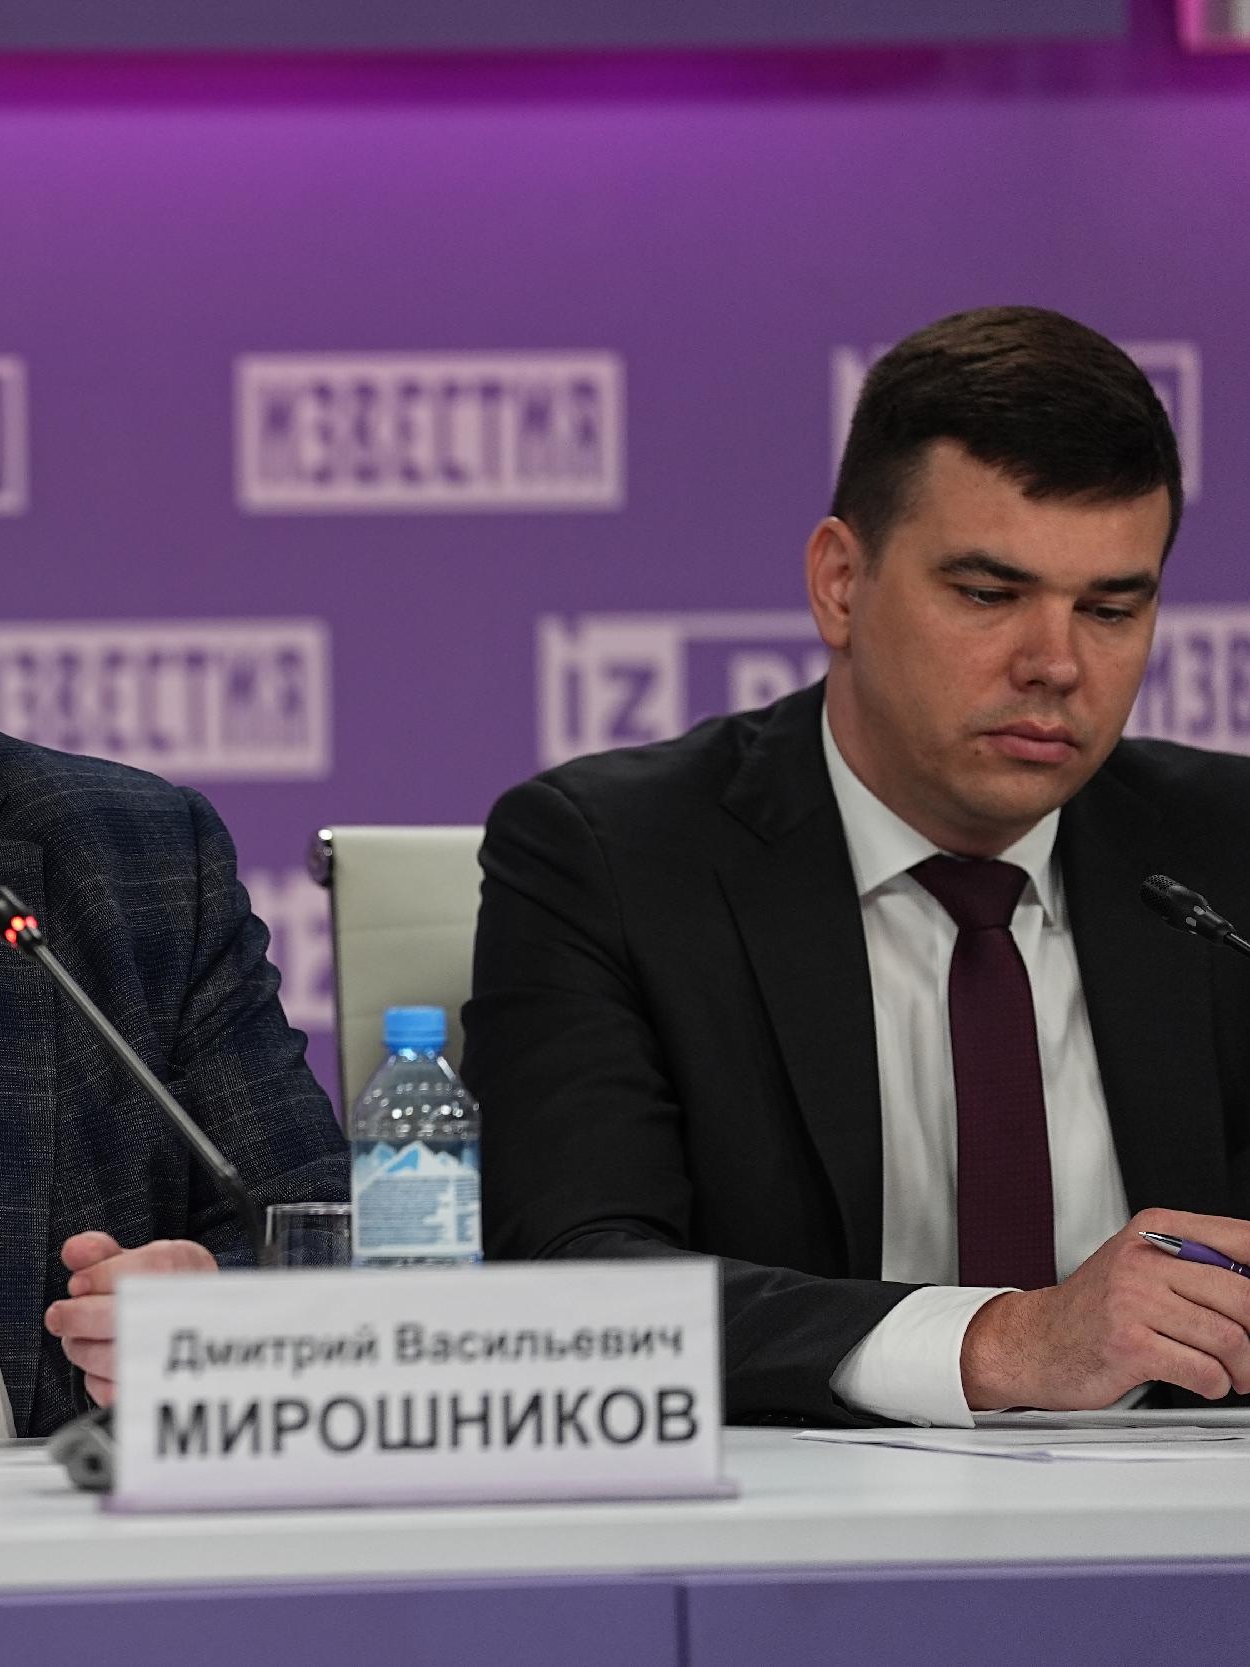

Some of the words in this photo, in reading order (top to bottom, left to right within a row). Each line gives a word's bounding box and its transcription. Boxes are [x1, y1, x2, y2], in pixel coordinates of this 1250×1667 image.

[257, 372, 606, 488] ИЗВЕСТИЯ
[163, 1323, 381, 1379] Дмитрий
[392, 1320, 685, 1367] Васильевич
[154, 1385, 700, 1460] МИРОШНИКОВ
